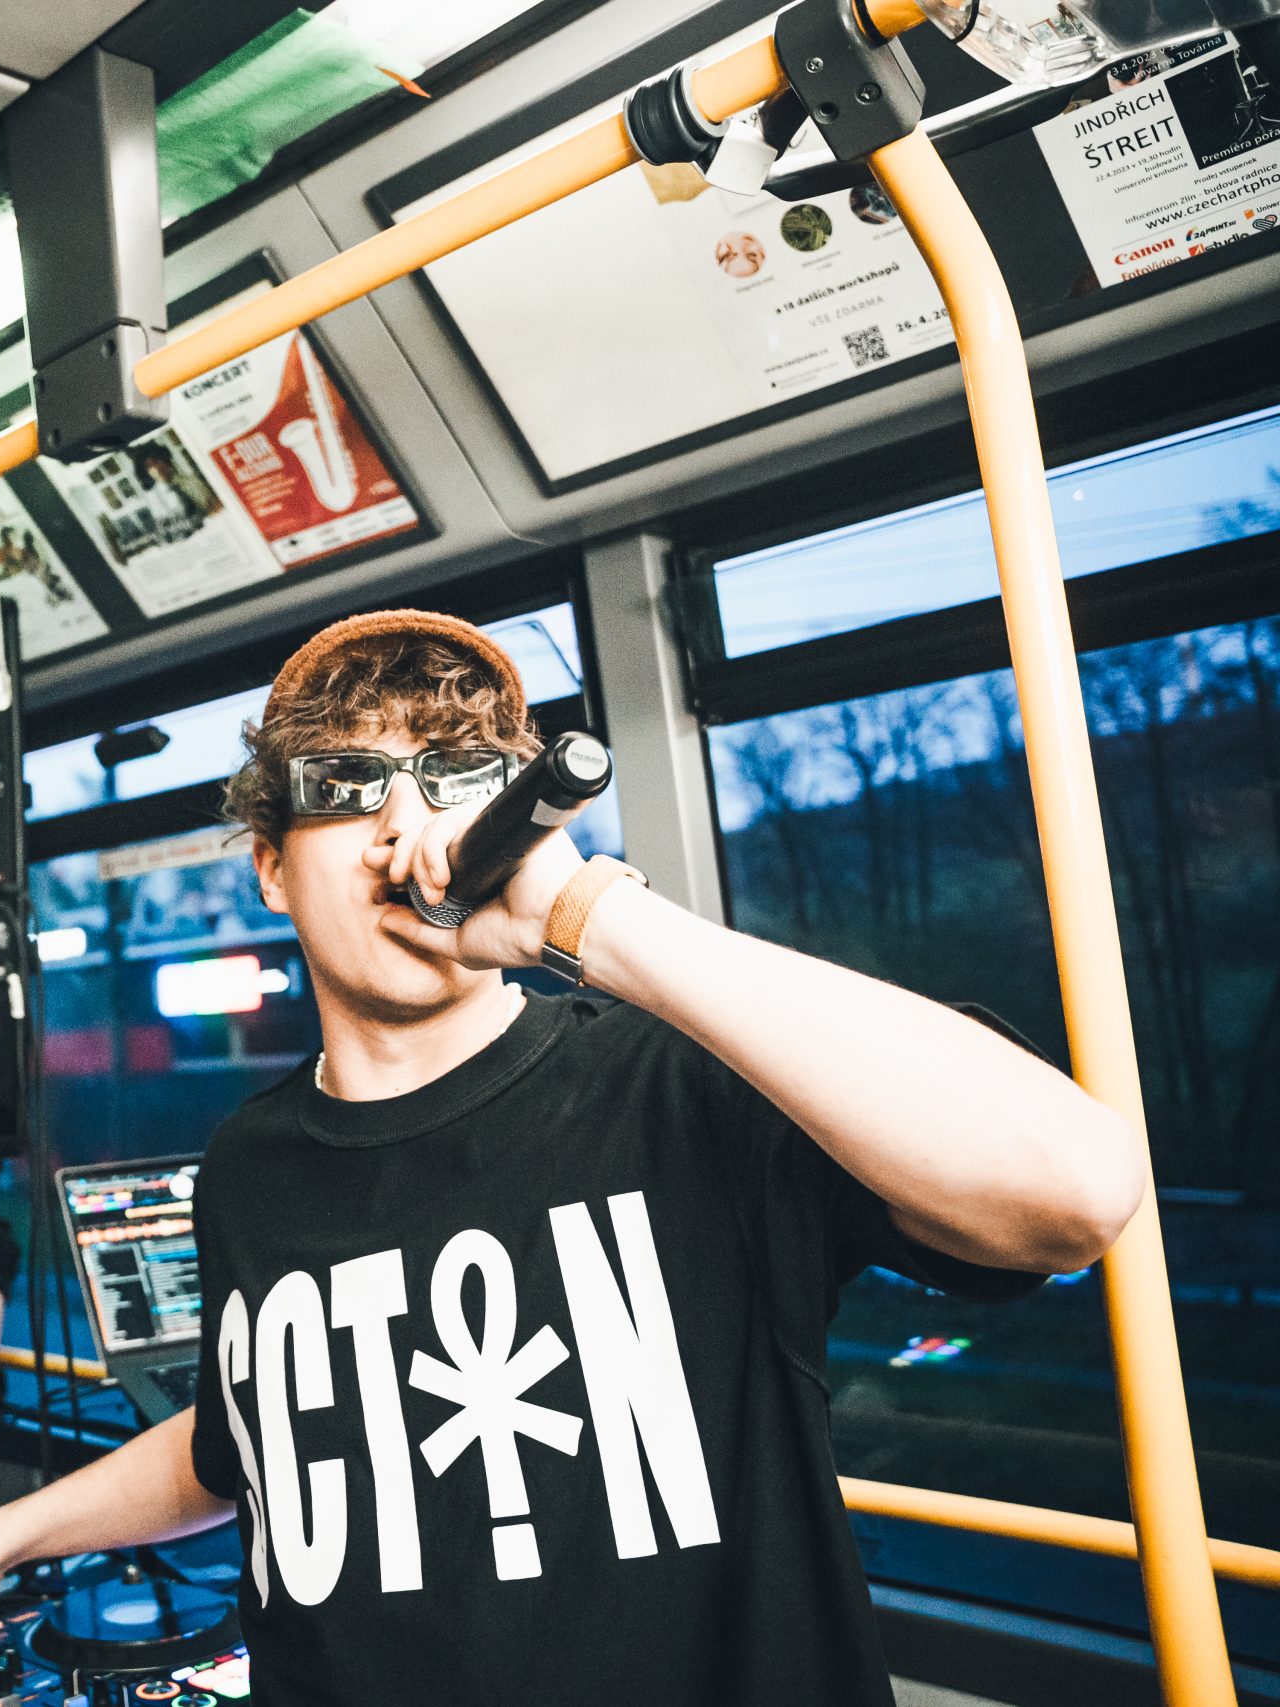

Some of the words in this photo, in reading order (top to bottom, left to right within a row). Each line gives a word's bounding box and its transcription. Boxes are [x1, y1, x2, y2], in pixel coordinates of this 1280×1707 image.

[1176, 36, 1221, 60] Továrna
[1074, 88, 1165, 138] JINDŘICH
[1083, 116, 1174, 169] ŠTREIT
[1159, 145, 1182, 157] hodin
[1202, 140, 1252, 164] Premiéra
[1144, 159, 1172, 173] budova
[1153, 162, 1188, 179] knihovna
[1194, 172, 1218, 185] Prodej
[1219, 157, 1257, 175] vstupenek
[1125, 201, 1178, 224] Infocentrum
[1203, 178, 1239, 195] budova
[1241, 163, 1278, 181] radnice
[1145, 173, 1280, 229] www.czechartpho
[1114, 238, 1175, 265] Canon
[837, 261, 900, 291] workshopů
[836, 295, 885, 319] ZDARMA
[183, 360, 250, 399] KONCERT
